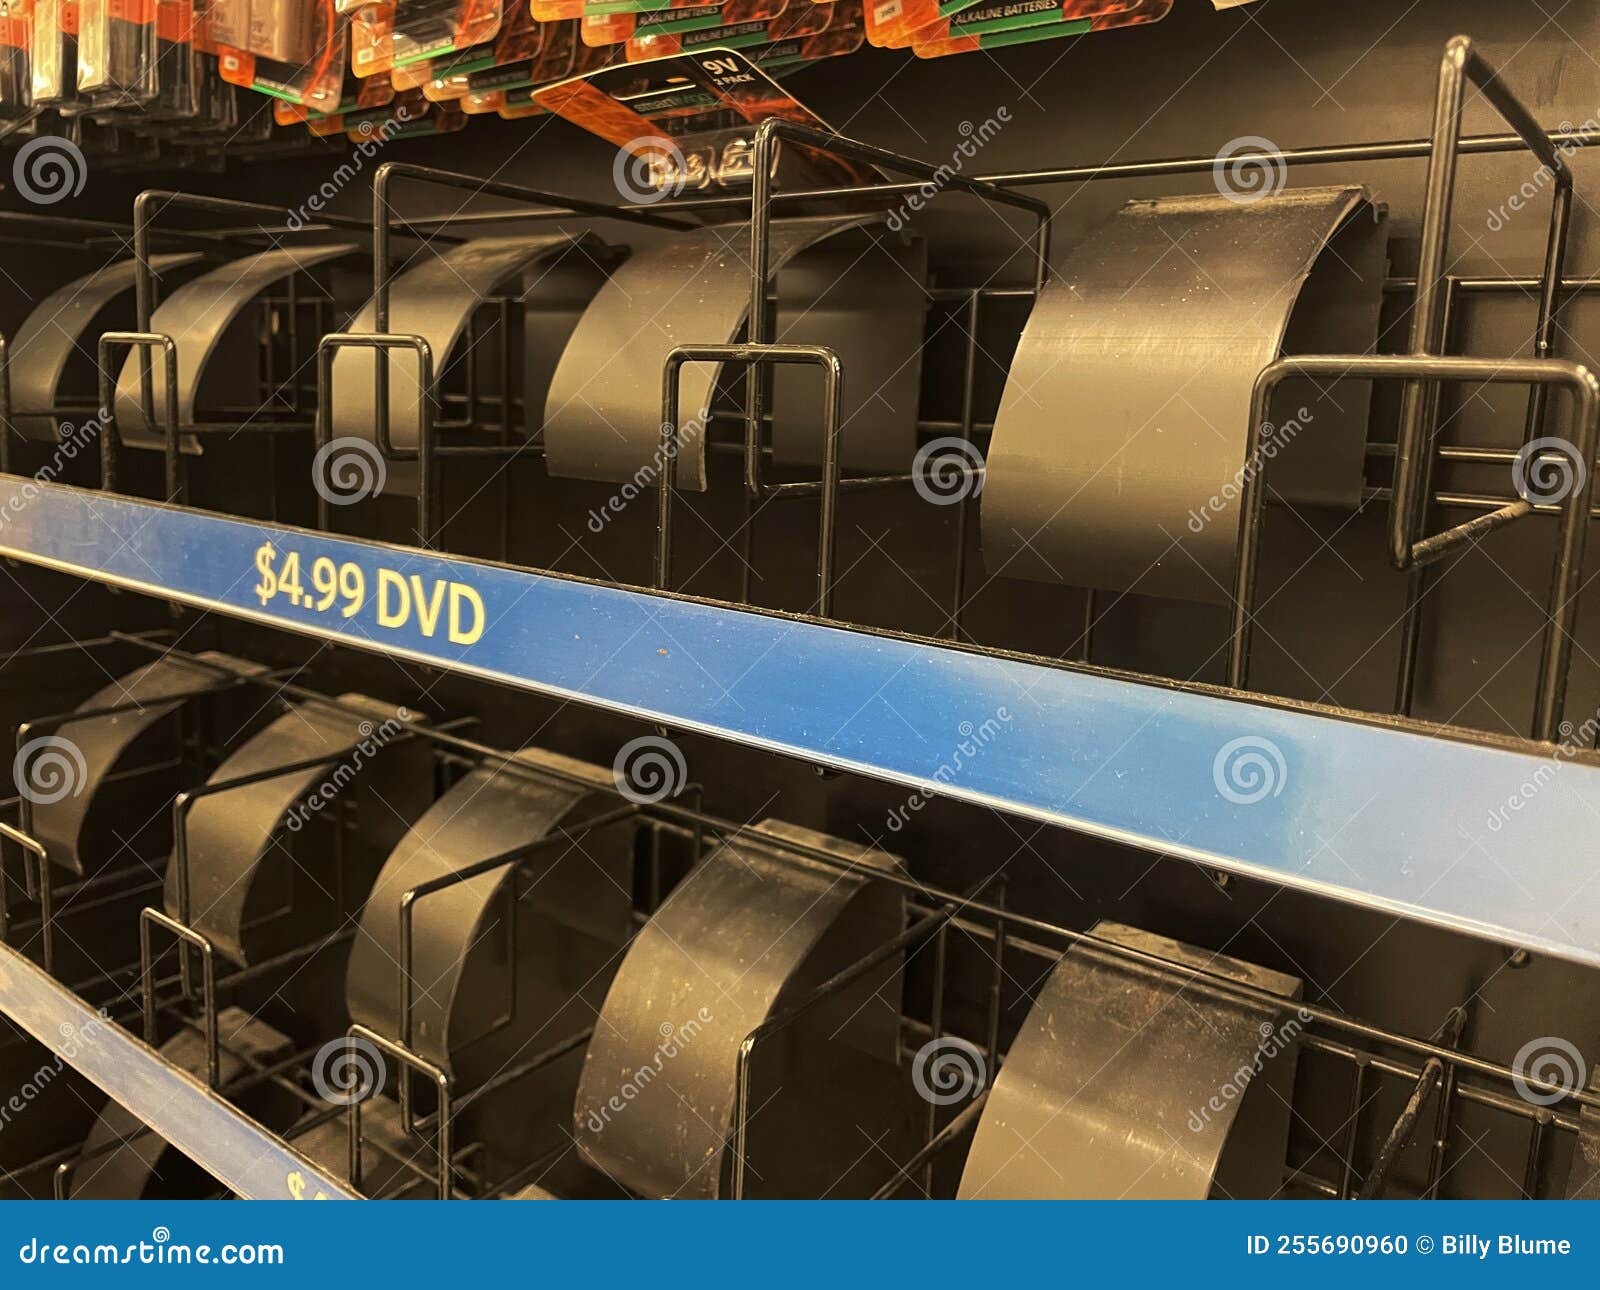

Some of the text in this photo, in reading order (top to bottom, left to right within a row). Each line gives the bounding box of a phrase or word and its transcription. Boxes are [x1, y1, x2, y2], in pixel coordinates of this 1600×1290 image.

[956, 0, 1058, 24] ALKALINE BATTERIES
[701, 57, 740, 76] 9V
[723, 73, 755, 85] PACK
[255, 541, 486, 645] $4.99 DVD
